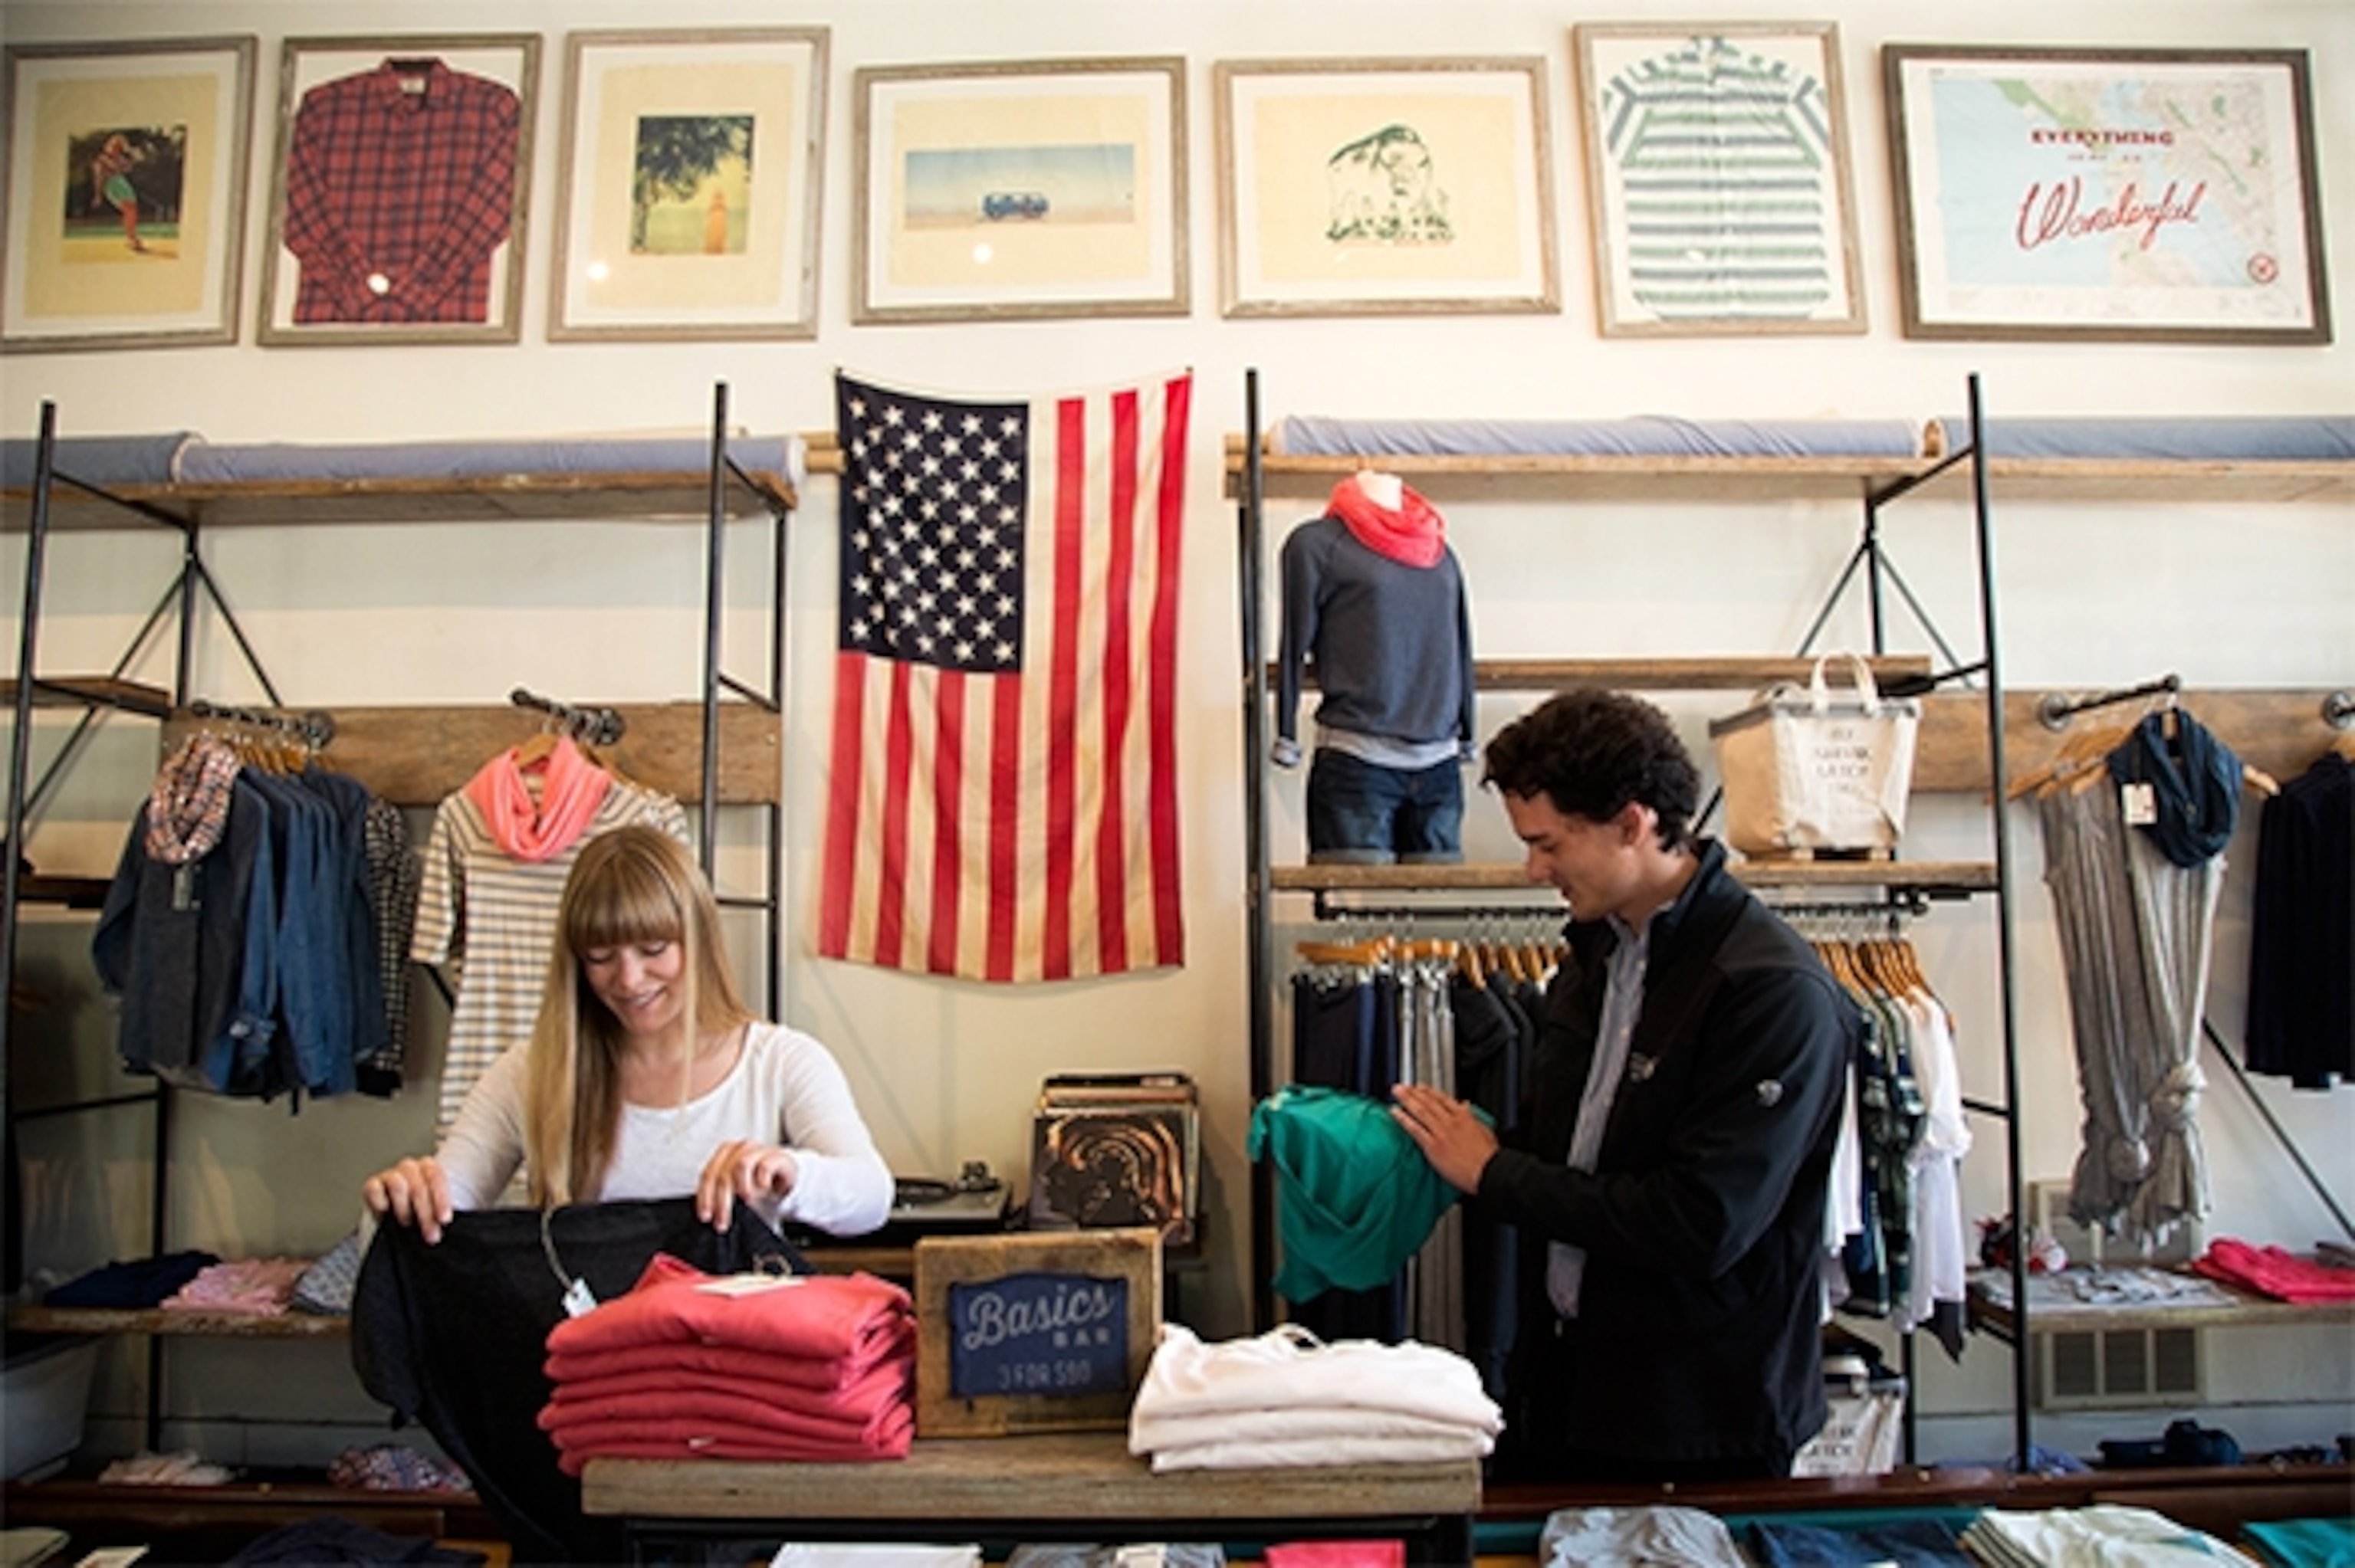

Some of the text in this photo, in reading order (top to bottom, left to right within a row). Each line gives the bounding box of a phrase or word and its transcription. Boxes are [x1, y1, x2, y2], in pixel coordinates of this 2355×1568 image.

[2031, 129, 2176, 147] EVERYTHING
[2015, 176, 2208, 251] Wonderful
[963, 1283, 1115, 1350] Basics
